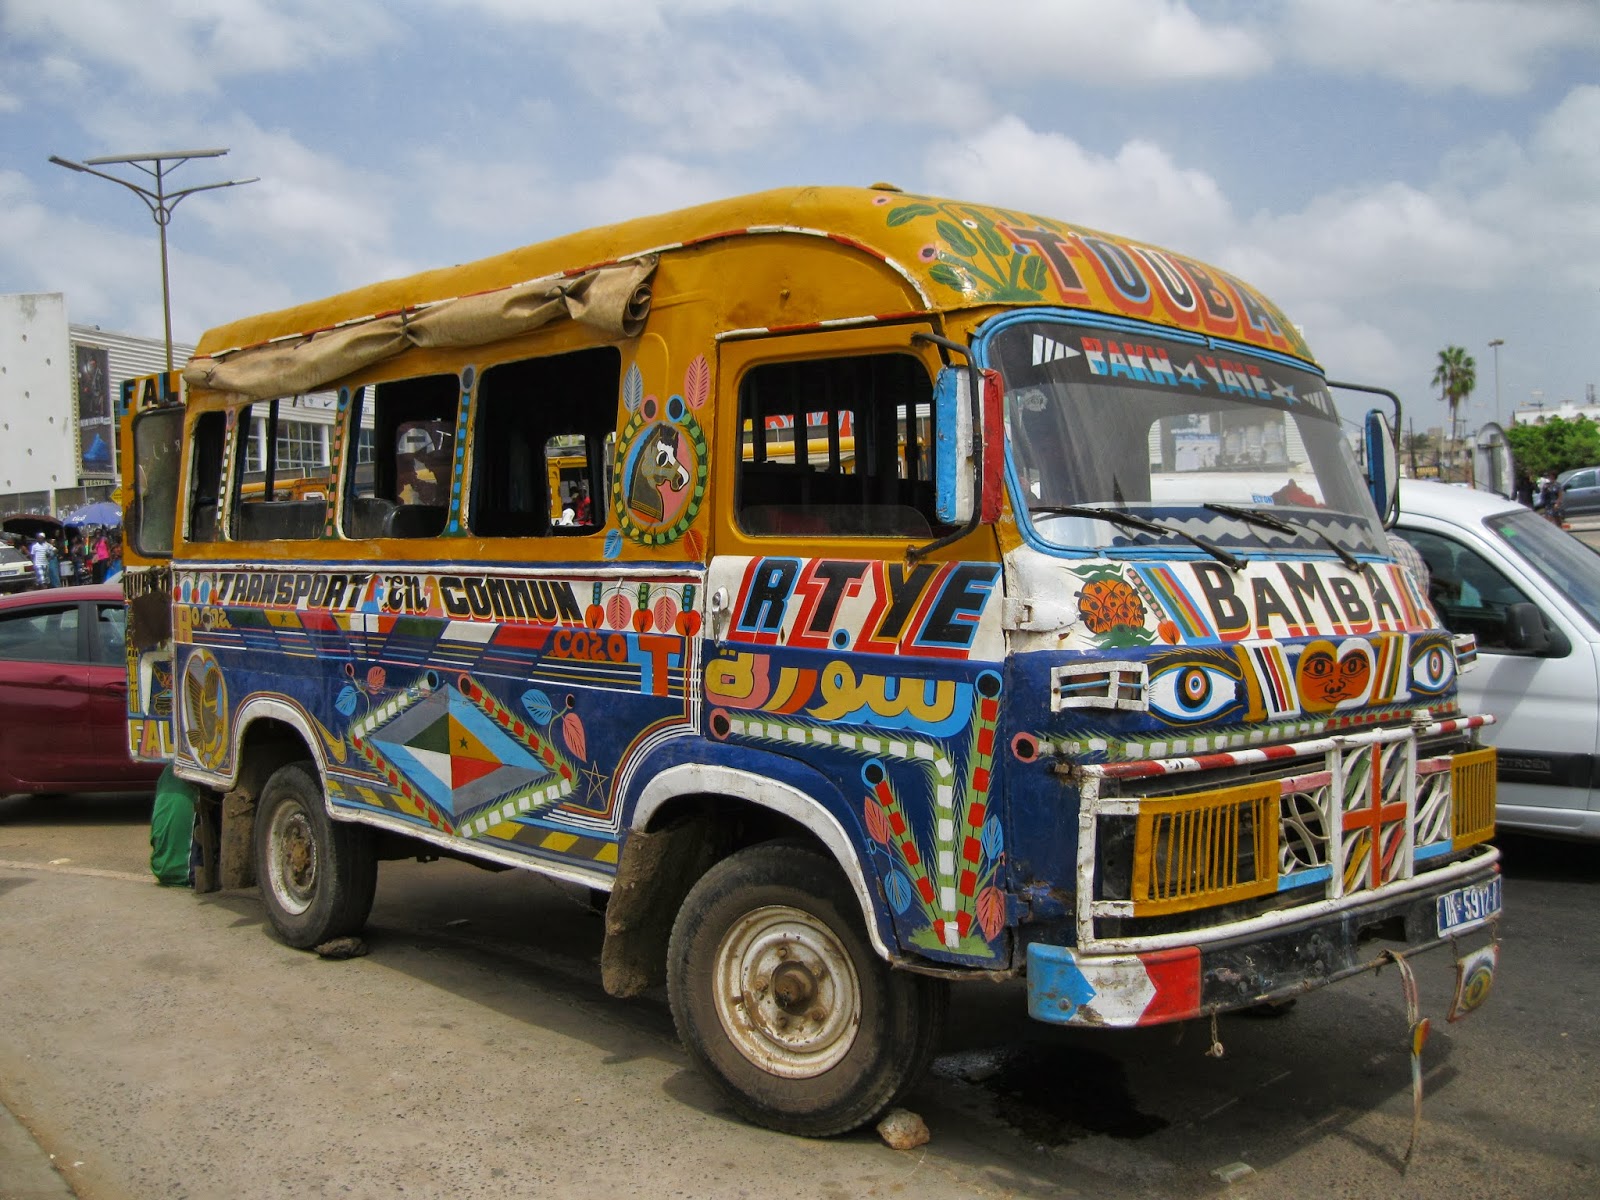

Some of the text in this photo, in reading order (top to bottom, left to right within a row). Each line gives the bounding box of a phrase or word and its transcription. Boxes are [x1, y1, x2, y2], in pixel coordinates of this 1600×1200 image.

[998, 222, 1288, 351] TOUBA
[217, 572, 364, 613] TRANSPORT
[438, 576, 586, 628] COMMUN
[1190, 561, 1407, 642] BAMBA
